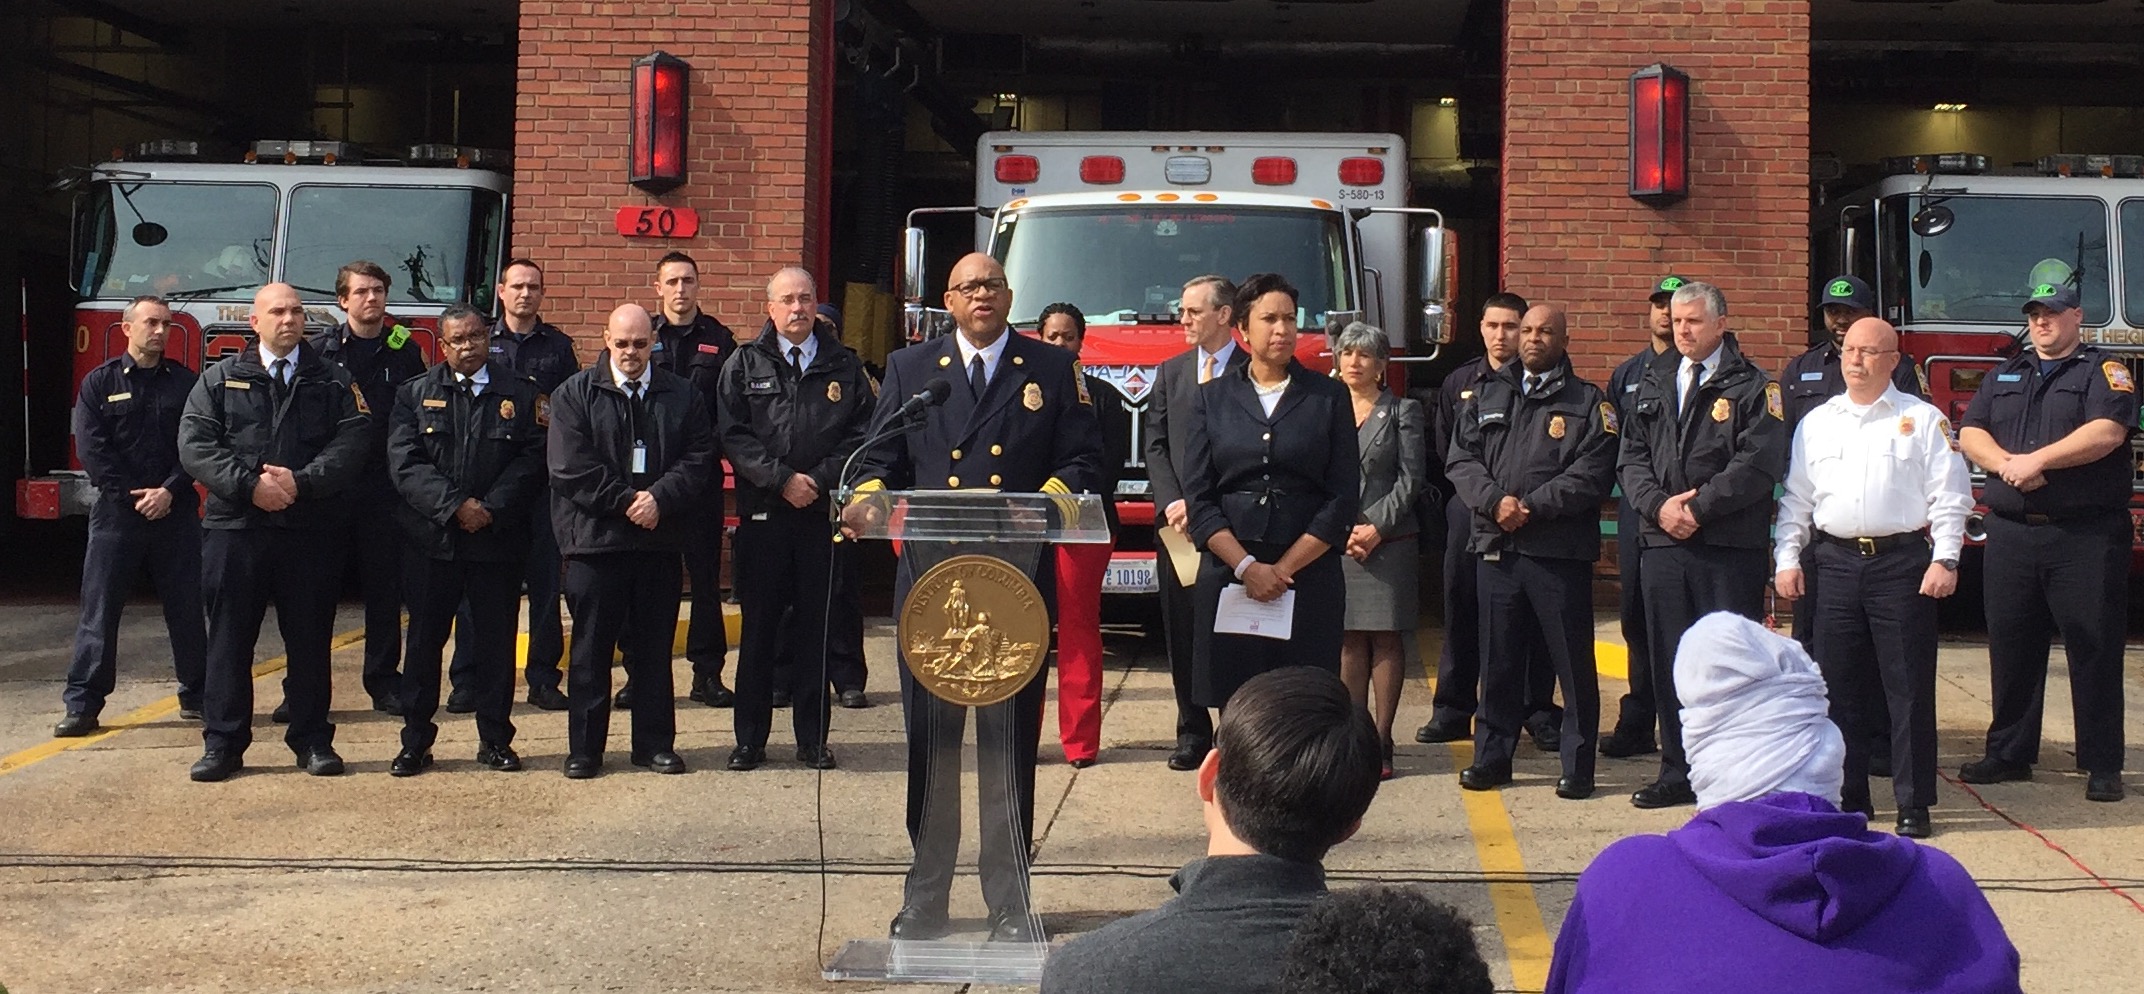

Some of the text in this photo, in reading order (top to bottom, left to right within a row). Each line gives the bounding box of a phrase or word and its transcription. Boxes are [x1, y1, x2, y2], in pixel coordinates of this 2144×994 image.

[1339, 189, 1385, 200] S-580-13
[636, 208, 676, 236] 50
[216, 305, 250, 321] THE
[2103, 329, 2144, 344] HEIG
[1116, 569, 1152, 586] 10198
